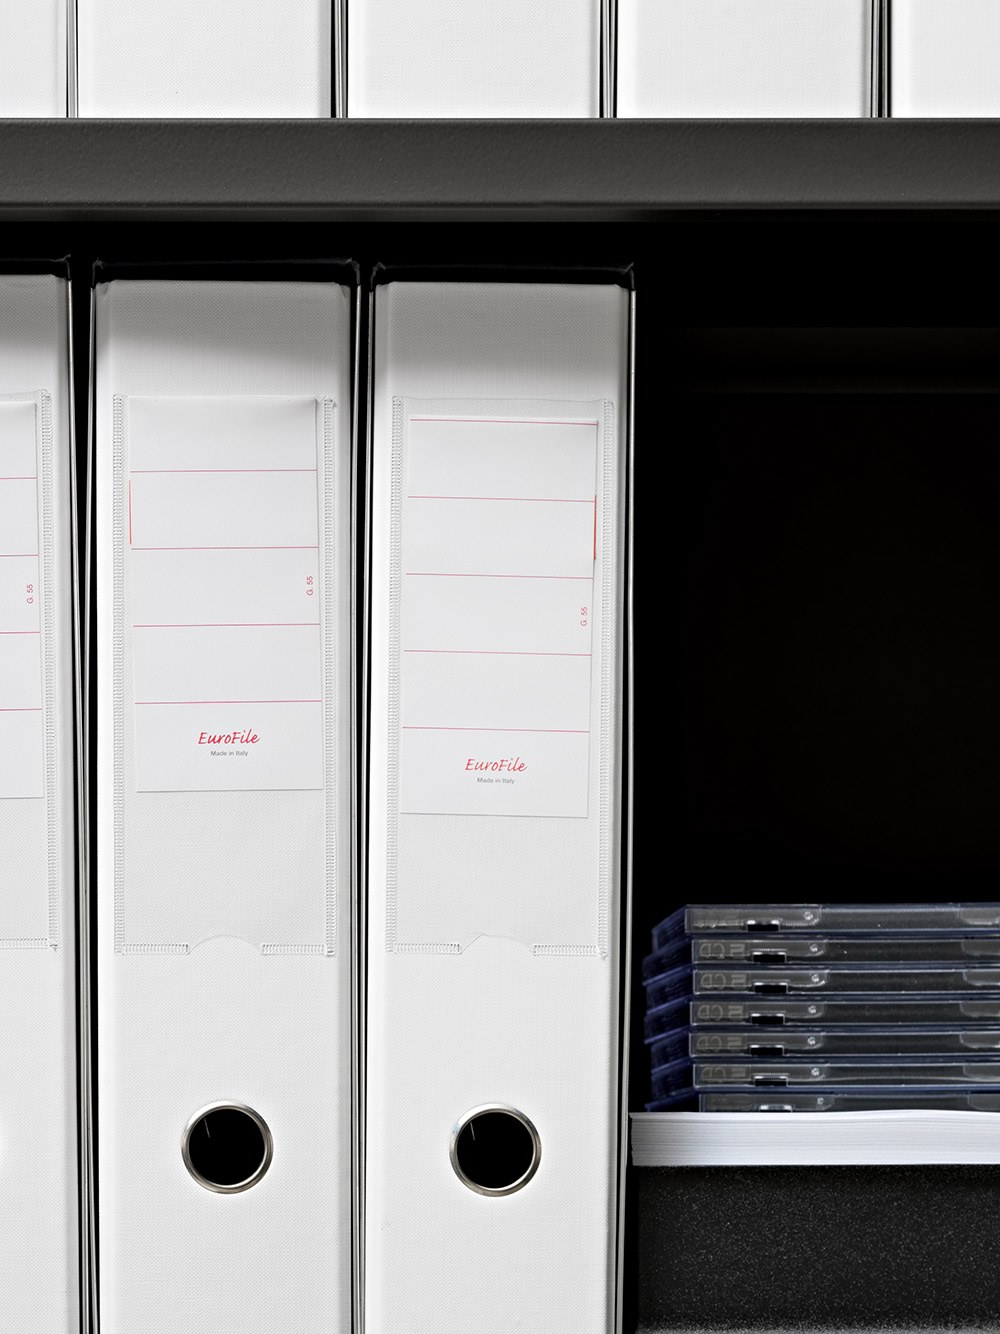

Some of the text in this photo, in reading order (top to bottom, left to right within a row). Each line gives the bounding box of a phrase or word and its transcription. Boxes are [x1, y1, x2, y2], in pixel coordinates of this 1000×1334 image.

[306, 575, 314, 585] 55
[26, 583, 34, 593] 55
[198, 728, 261, 745] EuroFile
[465, 756, 528, 772] EuroFile
